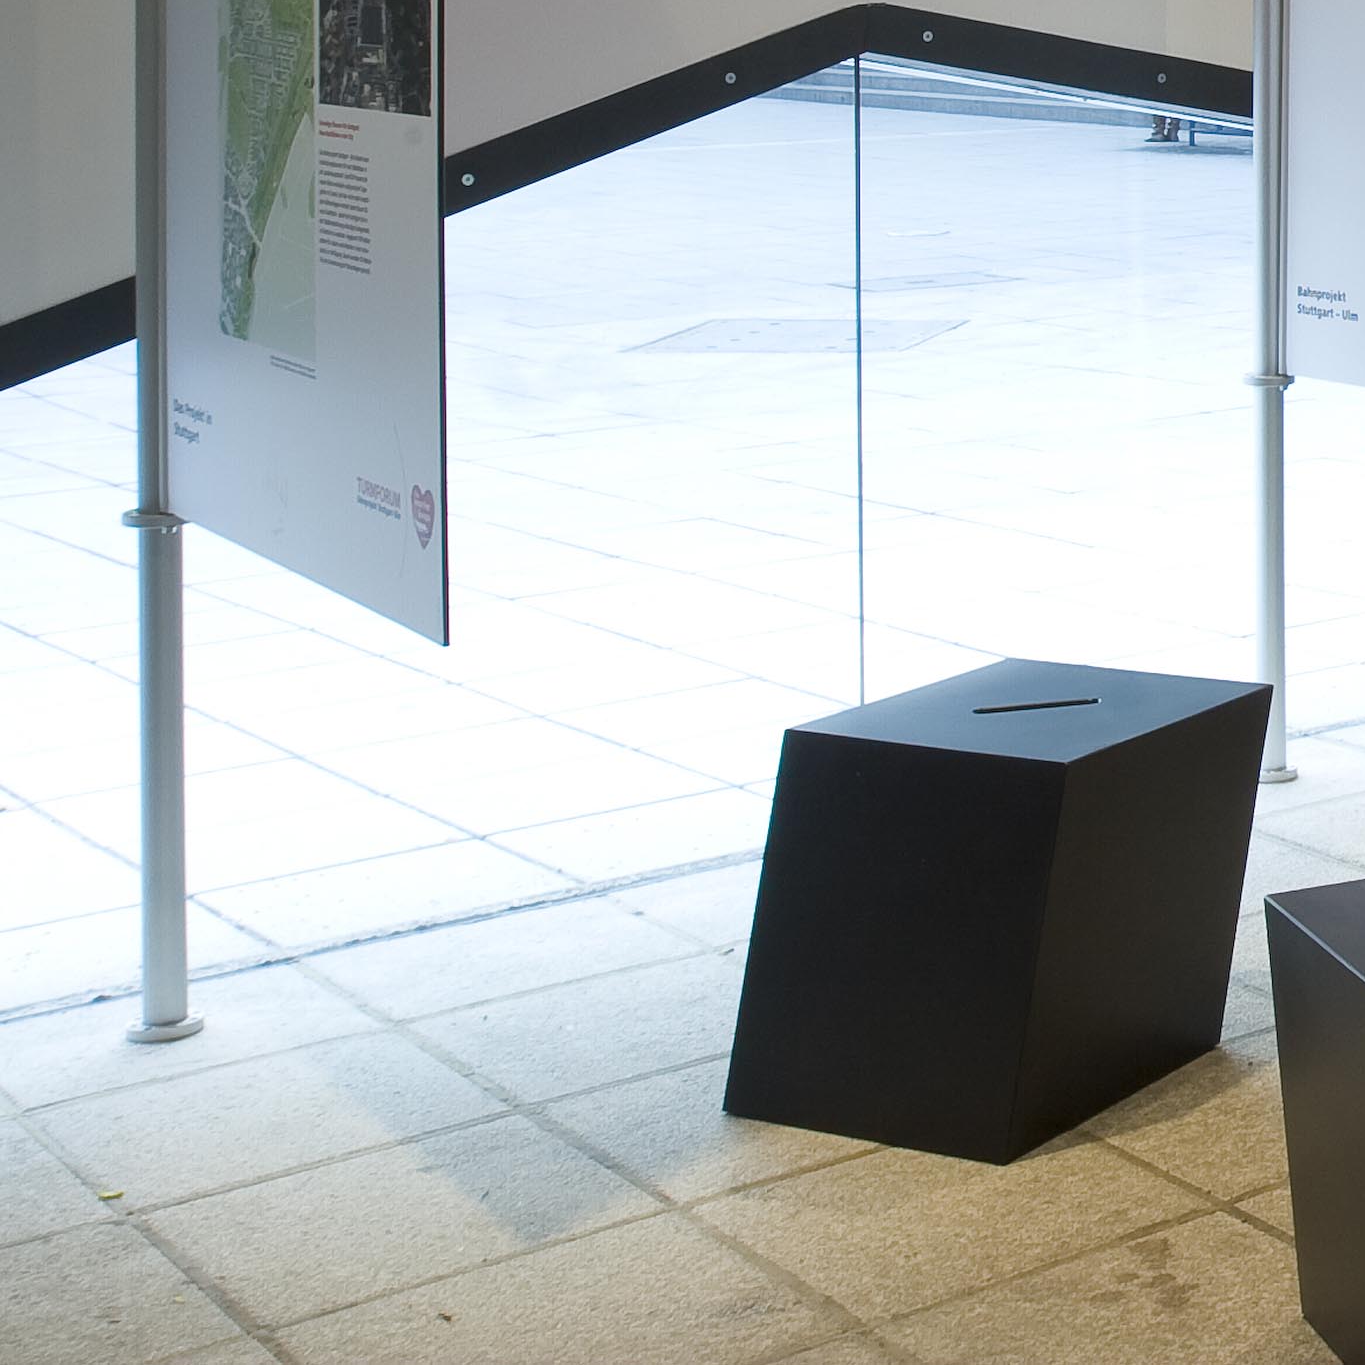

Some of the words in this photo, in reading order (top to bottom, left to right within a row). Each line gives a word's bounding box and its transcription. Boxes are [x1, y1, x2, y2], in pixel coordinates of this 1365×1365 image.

[1297, 285, 1346, 303] Bahnprojekt
[1297, 303, 1334, 319] Stuttgart
[1342, 309, 1359, 322] Ulm
